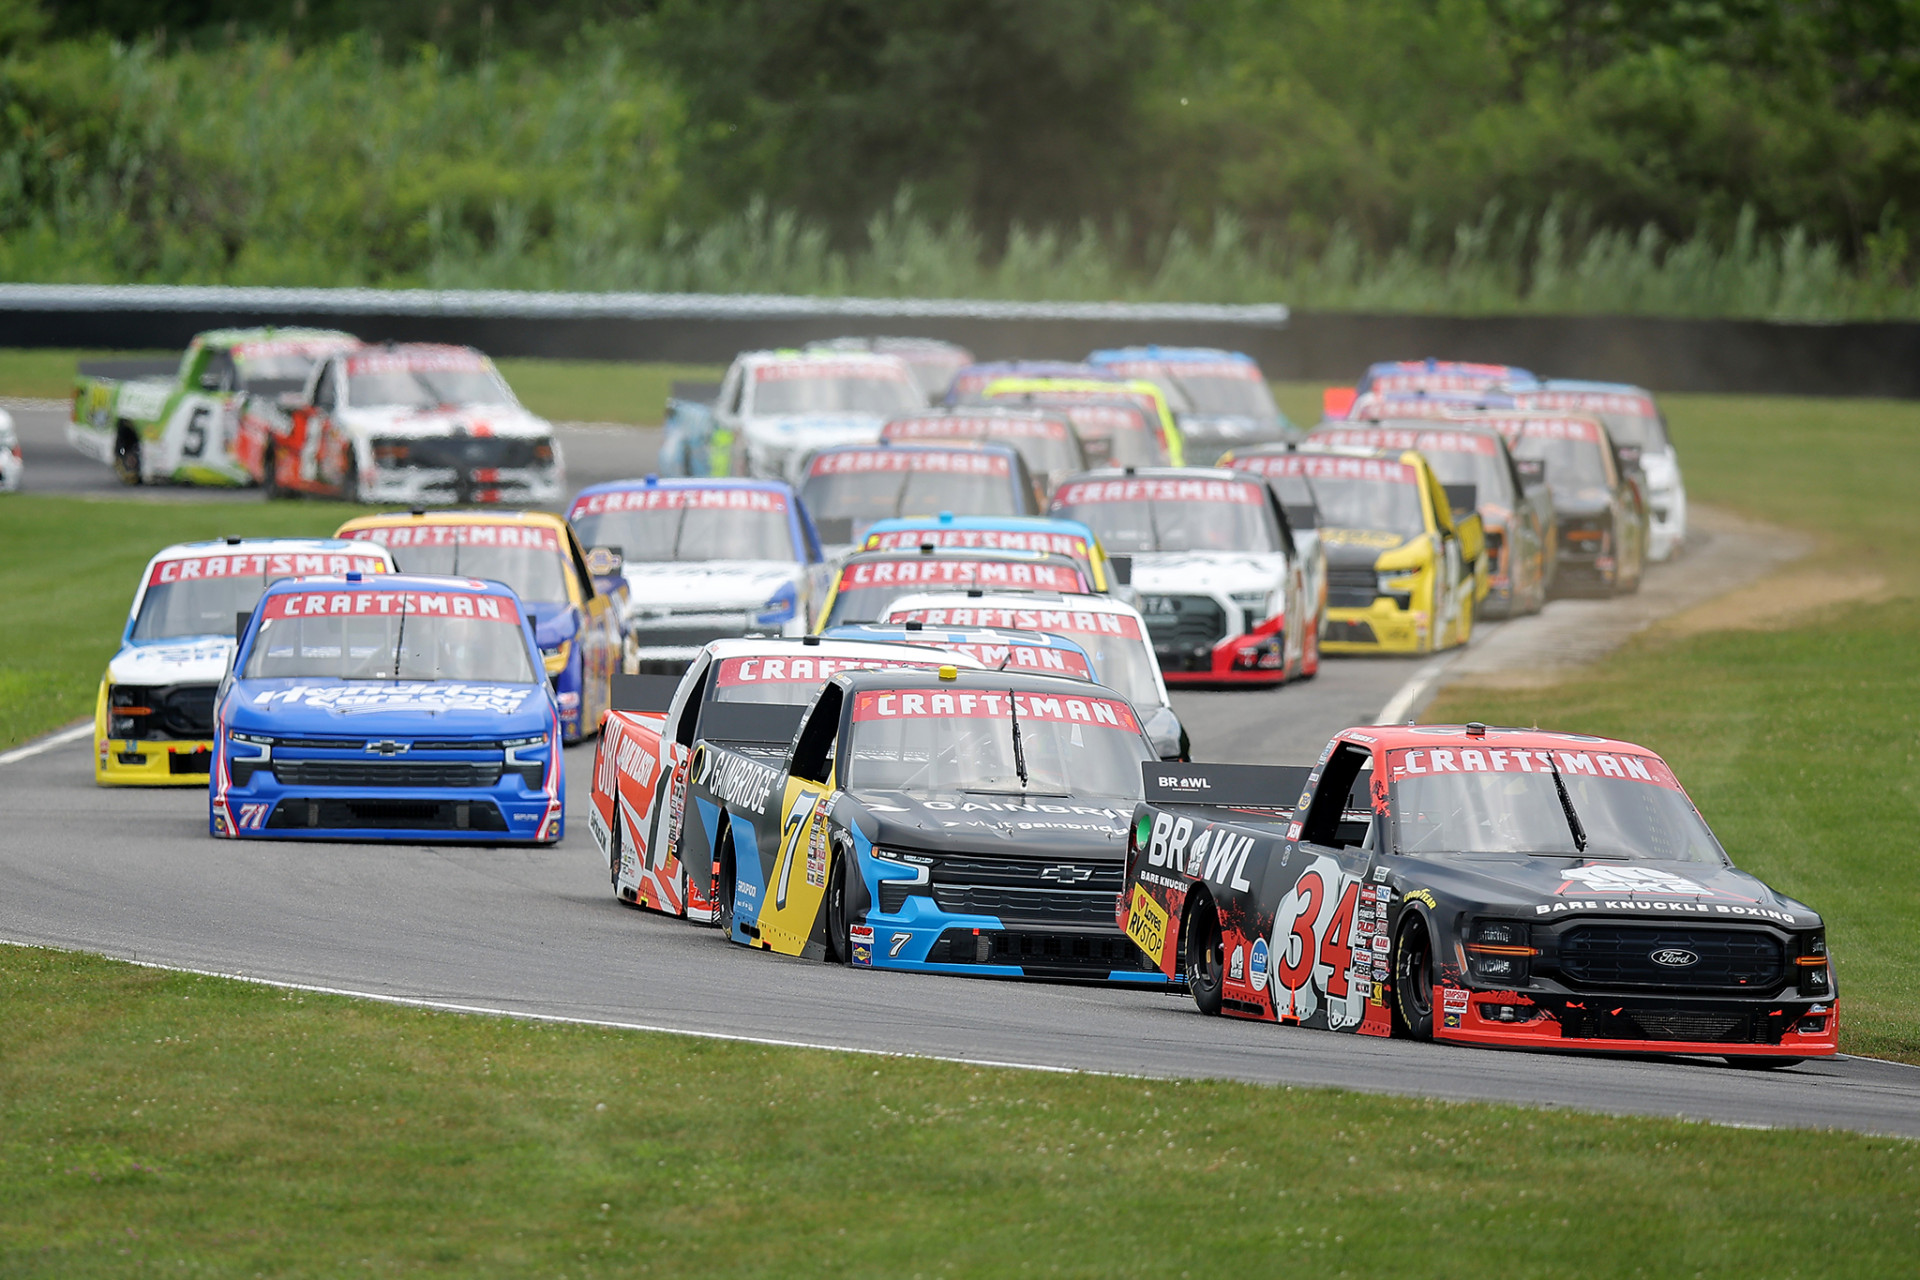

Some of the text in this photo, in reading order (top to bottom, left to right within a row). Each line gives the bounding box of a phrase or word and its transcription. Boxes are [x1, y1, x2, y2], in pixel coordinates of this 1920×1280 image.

[588, 489, 771, 513] CRAFTSMAN
[1066, 479, 1247, 502] CRAFTSMAN
[354, 525, 543, 549] CRAFTSMAN
[160, 555, 379, 583] CRAFTSMAN
[854, 560, 1057, 585] CRAFTSMAN
[284, 594, 501, 618] CRAFTSMAN
[905, 609, 1123, 634] CRAFTSMAN
[253, 684, 532, 704] Hendrick
[877, 693, 1120, 726] CRAFTSMAN
[1405, 749, 1652, 780] CRAFTSMAN
[709, 751, 778, 815] GAINBRIDGE
[240, 803, 269, 829] 71
[775, 789, 821, 912] 7
[1140, 870, 1159, 884] BARE
[1403, 888, 1437, 910] GOODYEAR
[1536, 901, 1796, 924] BARE KNUCKLE BOXING
[851, 926, 873, 936] ARP
[1278, 870, 1360, 999] 34
[889, 932, 913, 957] 7
[1659, 951, 1690, 965] Ford
[1445, 990, 1468, 1000] SIMPSON
